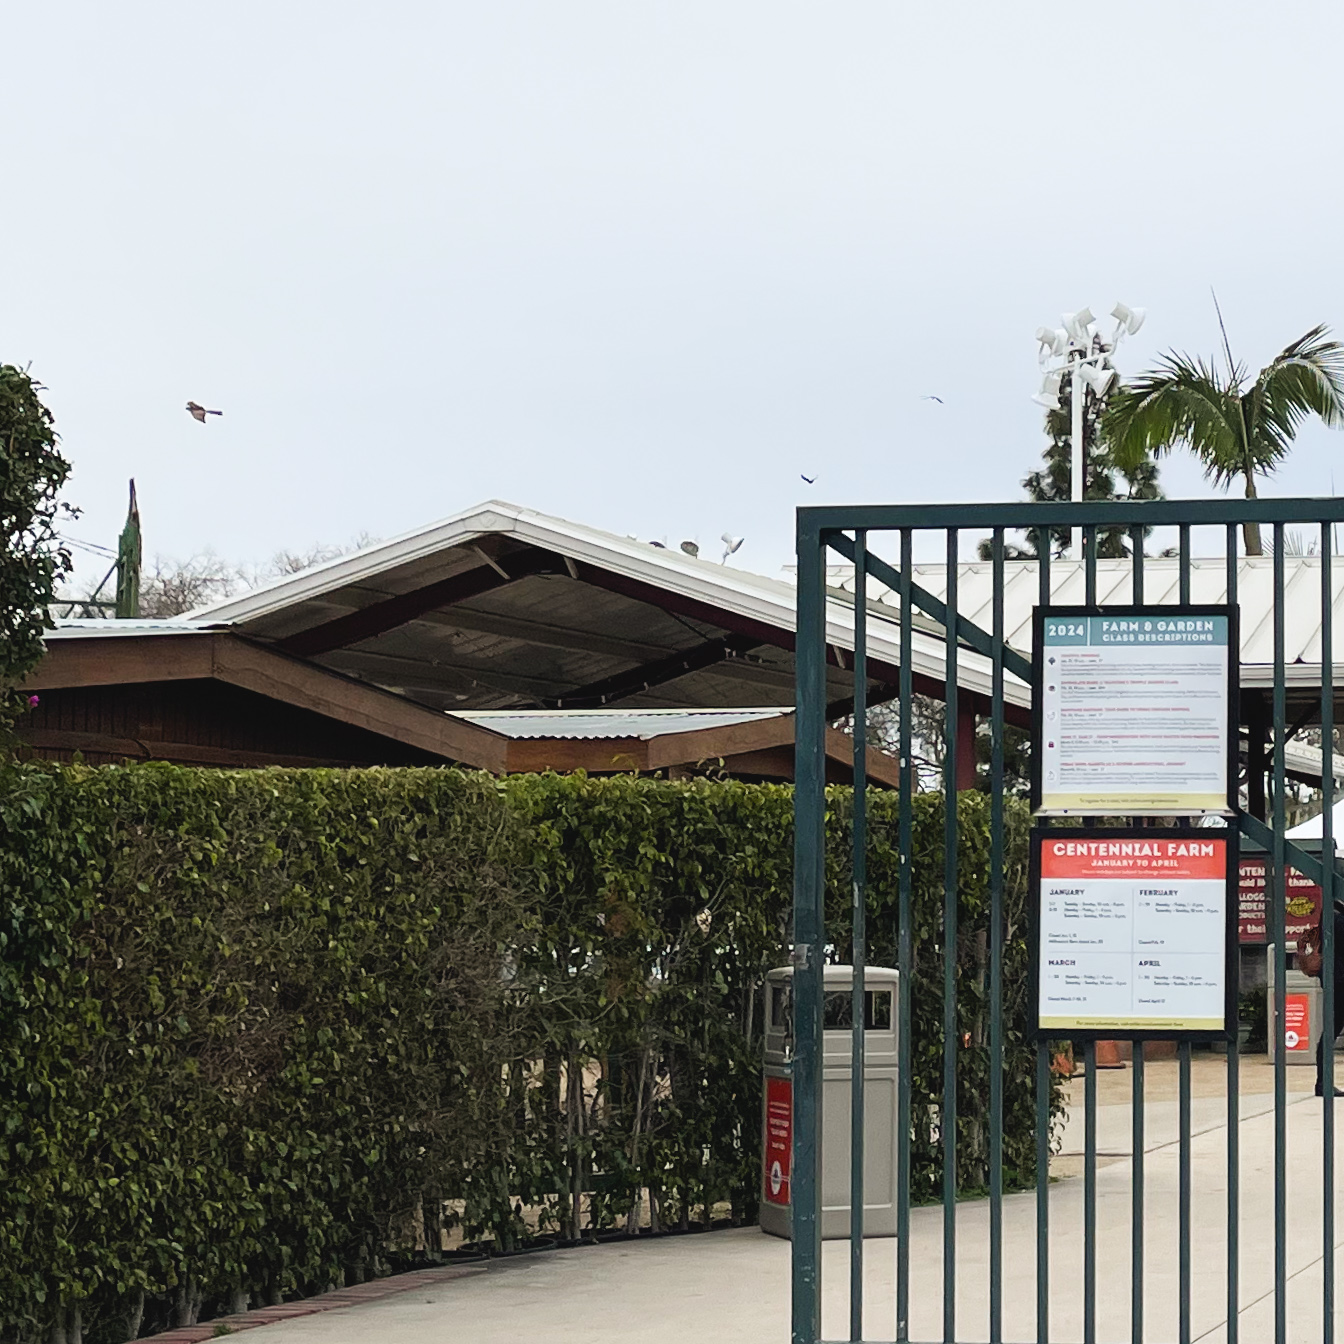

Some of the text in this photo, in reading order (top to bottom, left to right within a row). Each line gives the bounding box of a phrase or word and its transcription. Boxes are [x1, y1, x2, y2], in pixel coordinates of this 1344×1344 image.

[1048, 620, 1214, 636] 2024 FARM & GARDEN
[1102, 633, 1213, 642] CLASS DESCRIPTIONS
[1053, 842, 1214, 857] CENTENNIAL FARM
[1091, 859, 1179, 867] JANUARY TO APRIL
